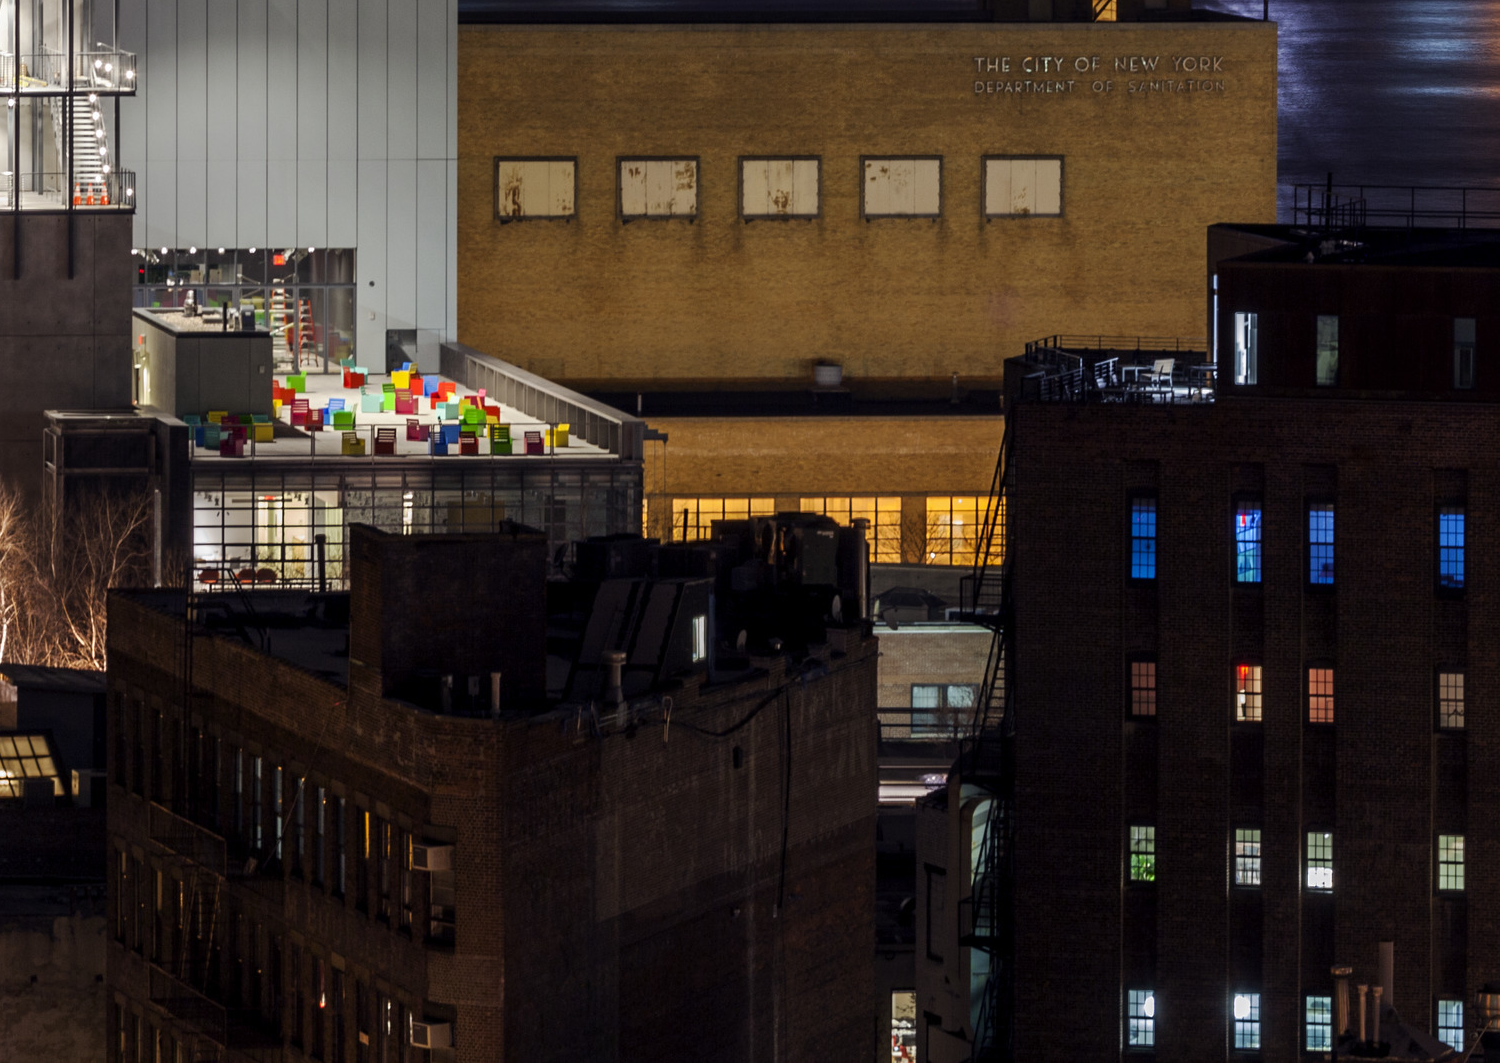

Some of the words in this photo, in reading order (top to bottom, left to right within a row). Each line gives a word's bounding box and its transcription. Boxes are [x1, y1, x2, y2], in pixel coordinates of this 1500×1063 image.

[974, 57, 1011, 73] THE
[1022, 56, 1064, 73] CITY
[1074, 56, 1100, 72] OF
[1114, 56, 1160, 72] NEW
[1172, 56, 1224, 73] YORK
[974, 80, 1075, 94] DEPARTMENT
[1092, 80, 1113, 93] OF
[1128, 80, 1225, 93] SANITATION
